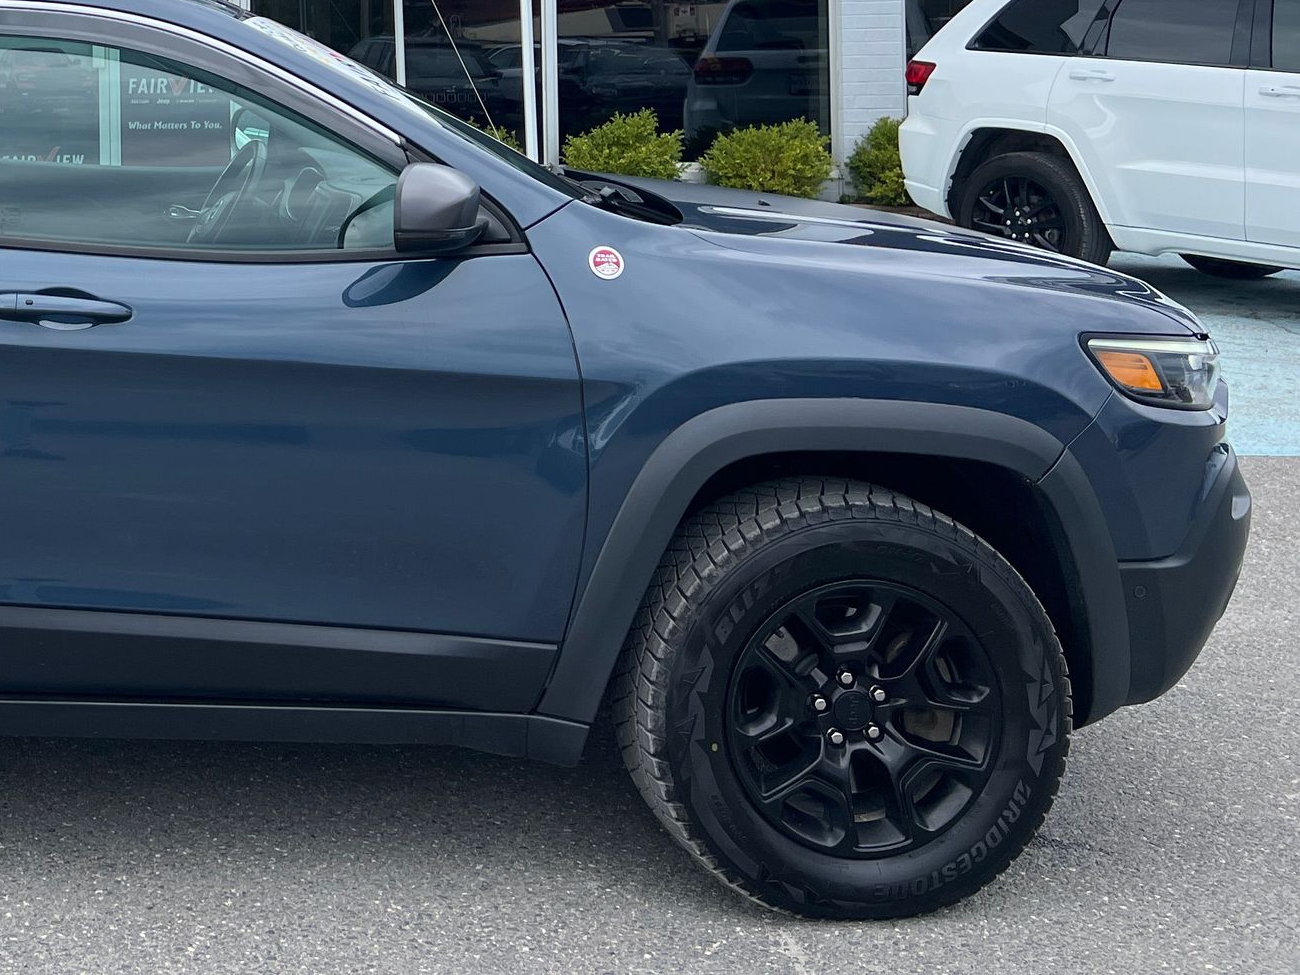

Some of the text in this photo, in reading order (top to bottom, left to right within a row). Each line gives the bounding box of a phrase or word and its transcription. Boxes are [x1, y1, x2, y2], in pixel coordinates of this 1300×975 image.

[153, 121, 187, 129] Matters
[190, 121, 201, 129] To
[203, 121, 222, 129] You.
[874, 779, 1032, 900] BRIDGESTONE
